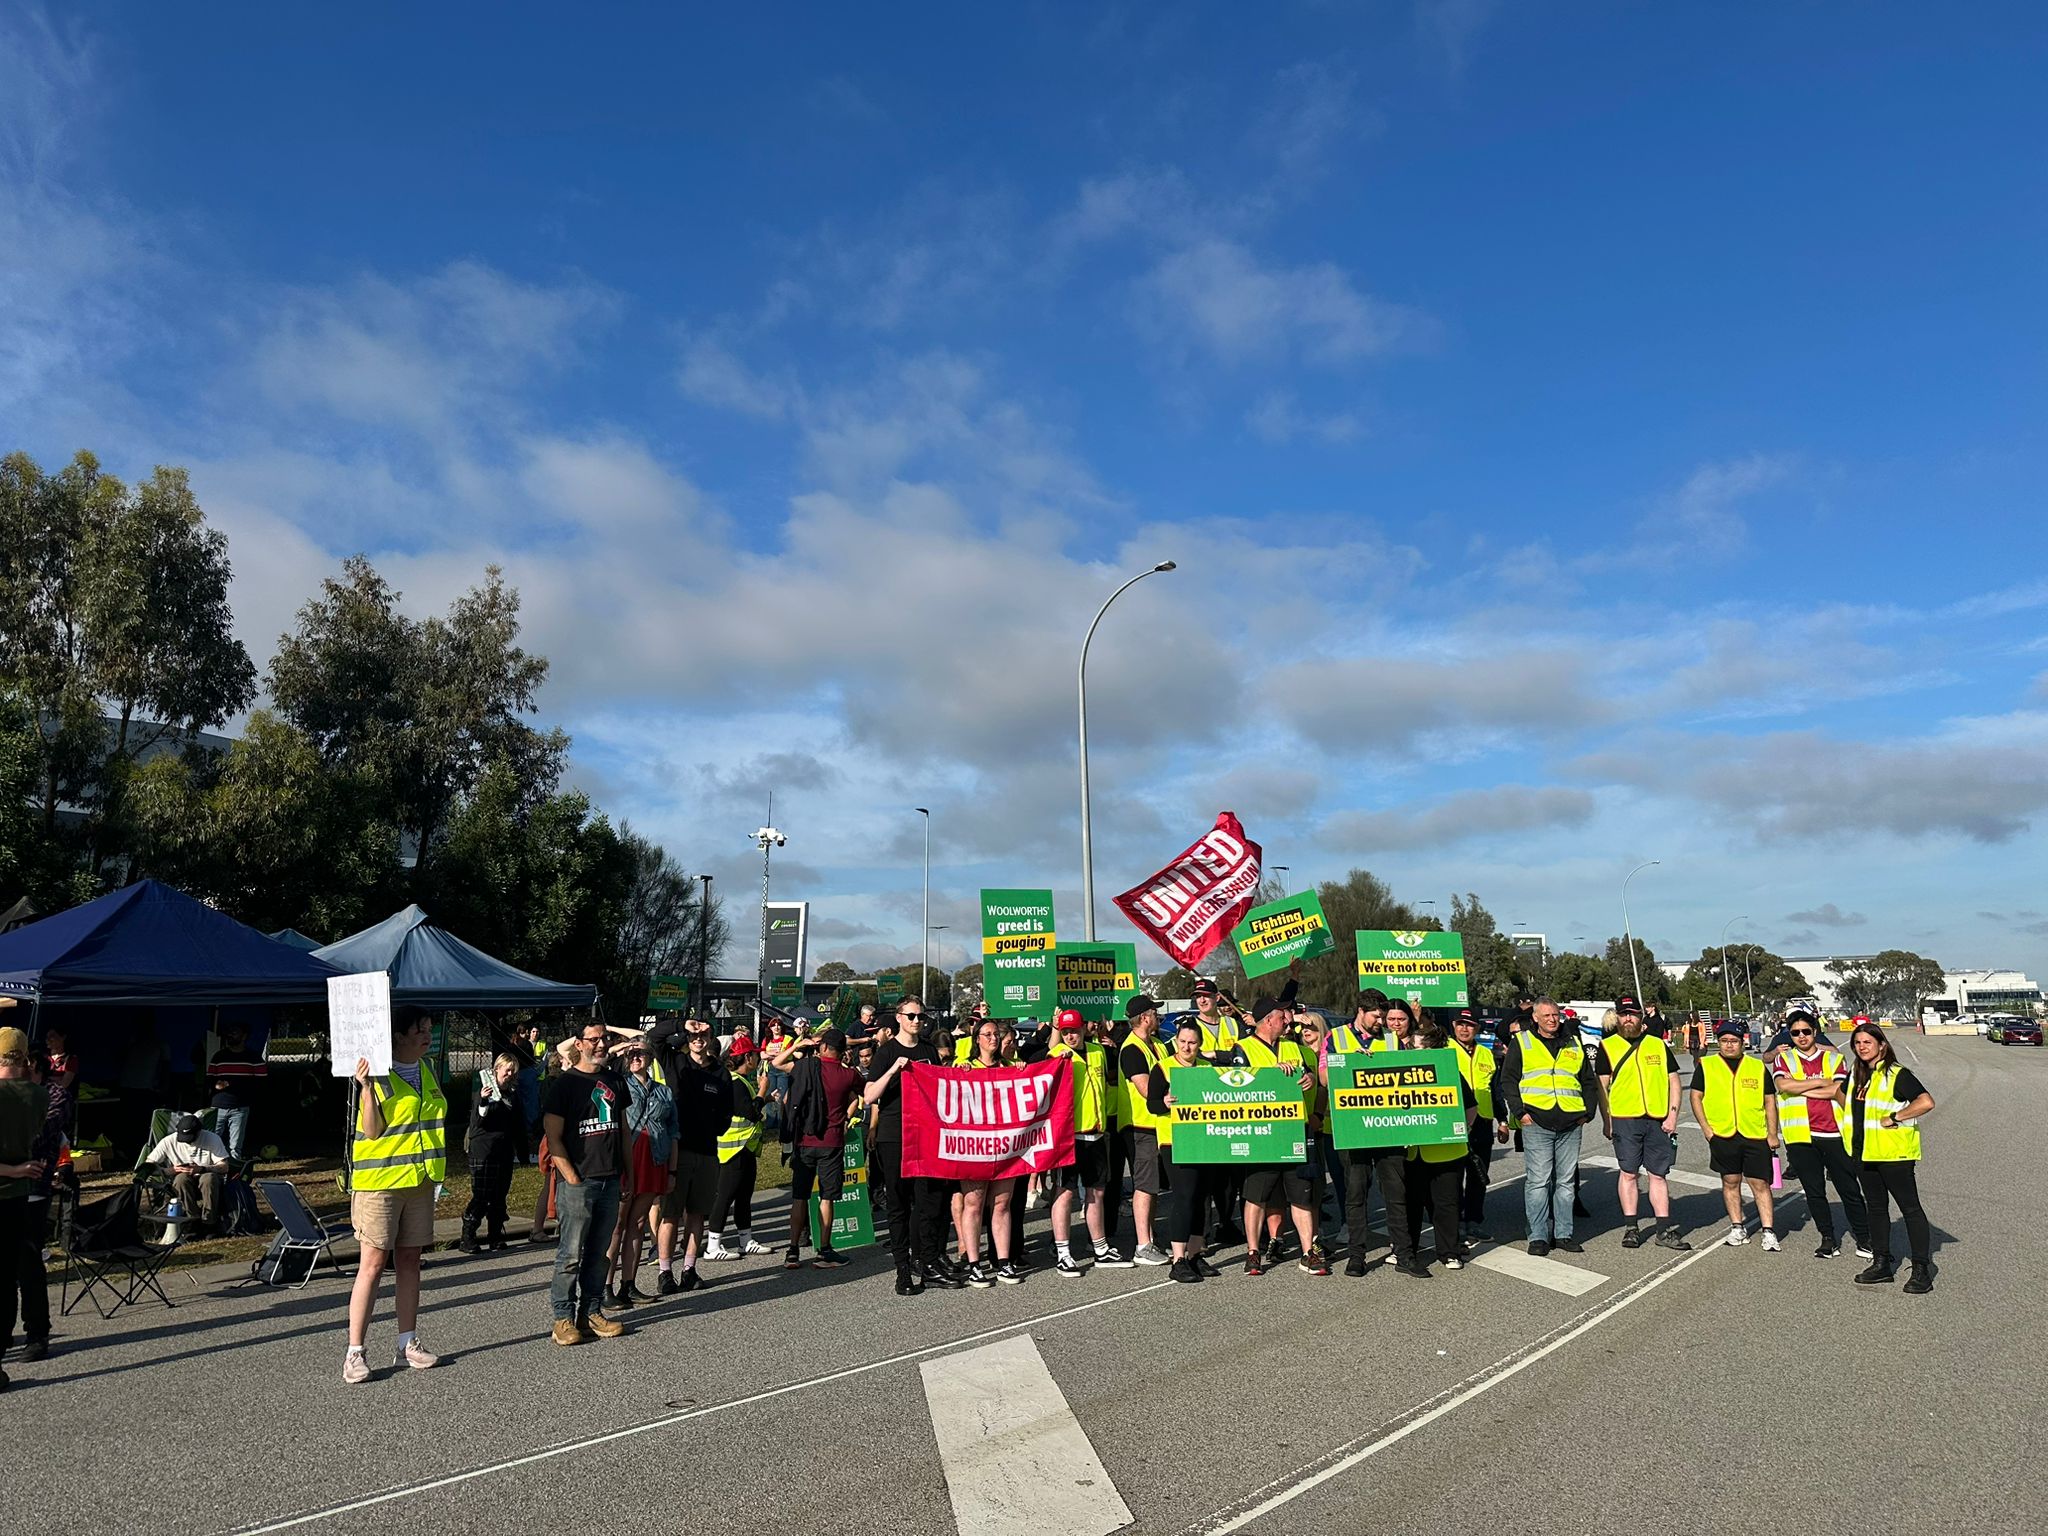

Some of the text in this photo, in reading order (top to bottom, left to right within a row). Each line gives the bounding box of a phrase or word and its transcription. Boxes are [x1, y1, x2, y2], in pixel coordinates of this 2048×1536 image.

[1132, 829, 1244, 928] UNITED
[987, 905, 1050, 916] WOOLWORTHS'
[1173, 863, 1260, 943] WORKERS UNION
[997, 919, 1044, 935] greed is
[1252, 911, 1304, 933] Fighting
[1245, 918, 1319, 952] for fair pay at
[996, 935, 1046, 953] gouging
[1261, 936, 1314, 959] WOOLWORTHS
[994, 955, 1046, 969] workers!
[1382, 949, 1442, 959] WOOLWORTHS
[1058, 957, 1114, 974] Fighting
[1363, 961, 1461, 973] We're not robots!
[1064, 976, 1088, 989] fair
[1091, 978, 1116, 992] pay
[1117, 976, 1129, 988] at
[1386, 975, 1440, 987] Respect us!
[1061, 995, 1120, 1004] WOOLWORTHS
[1355, 1067, 1435, 1088] Every site
[936, 1073, 1054, 1125] UNITED
[1202, 1091, 1277, 1103] WOOLWORTHS
[1339, 1090, 1453, 1110] same rights at
[1177, 1104, 1298, 1120] We're not robots!
[579, 1118, 599, 1127] FREE
[1361, 1114, 1438, 1128] WOOLWORTHS
[1206, 1123, 1272, 1138] Respect us!
[945, 1126, 1048, 1156] WORKERS UNION
[847, 1156, 856, 1167] is
